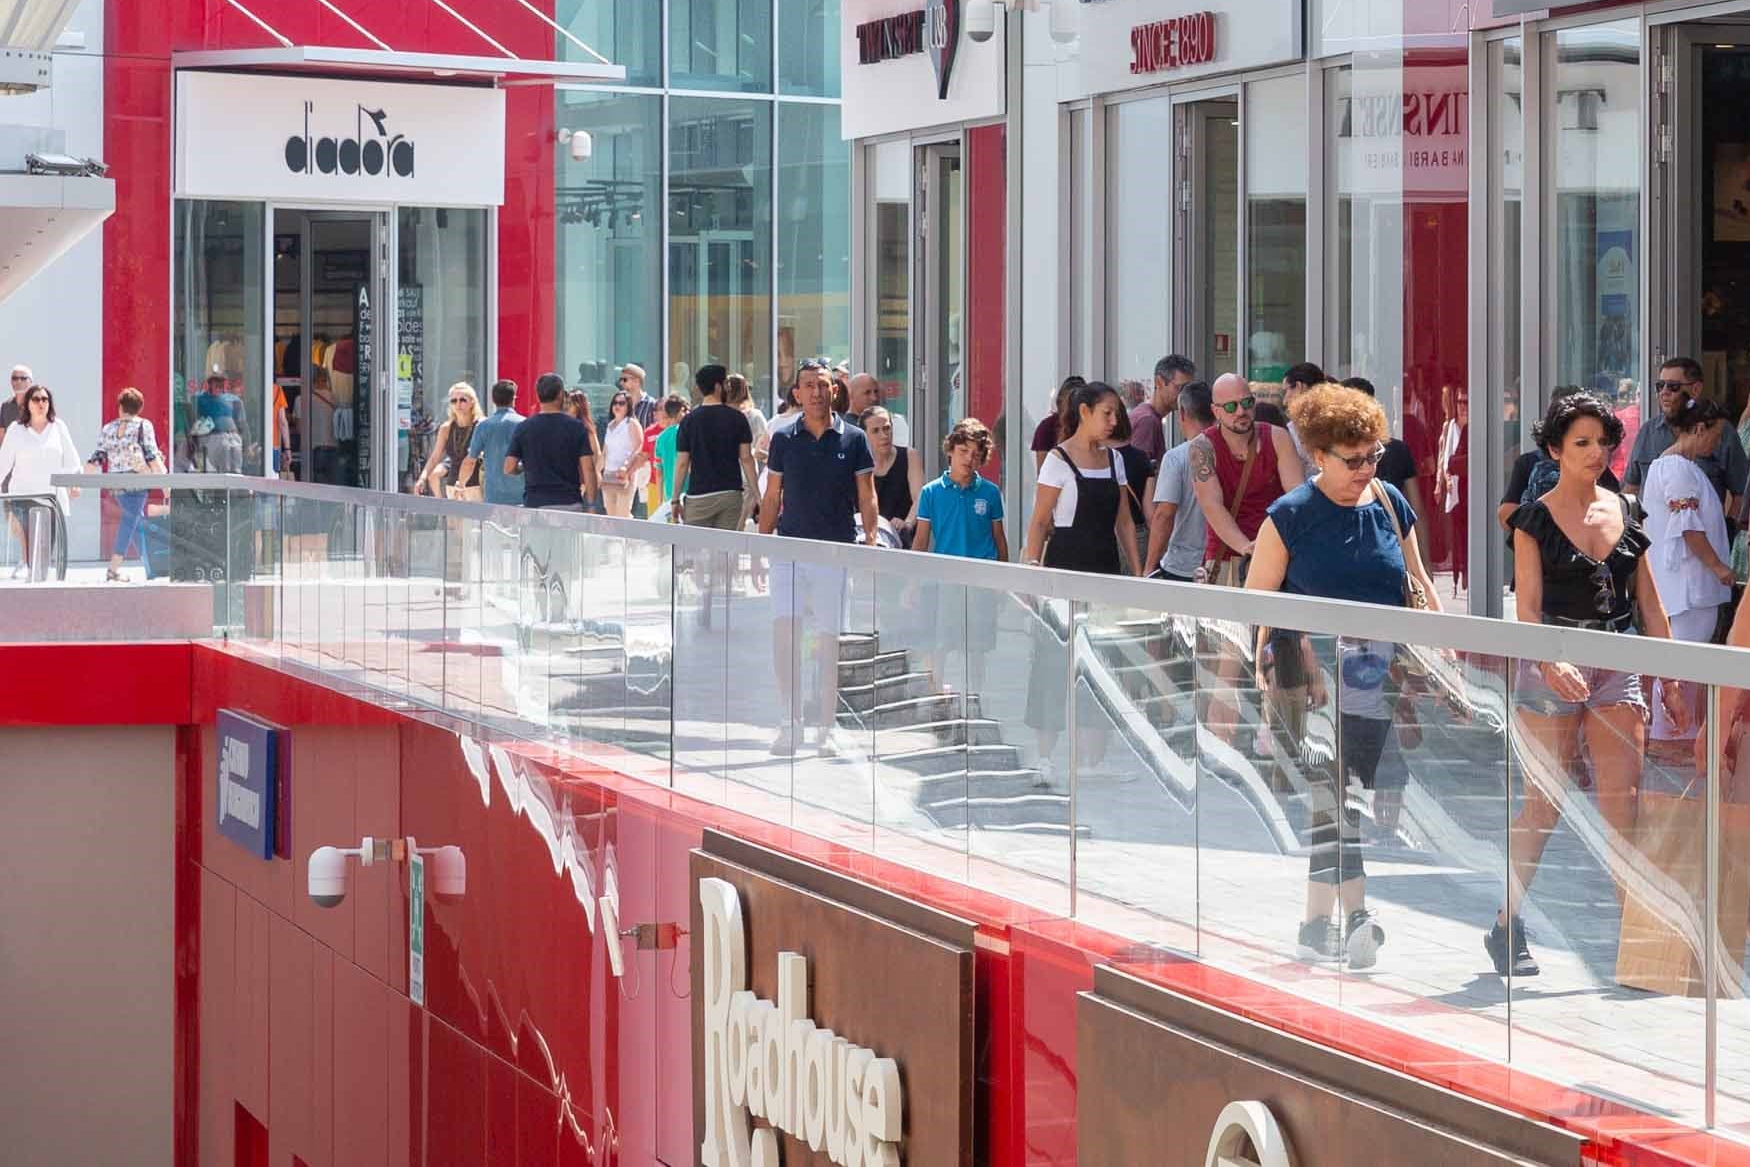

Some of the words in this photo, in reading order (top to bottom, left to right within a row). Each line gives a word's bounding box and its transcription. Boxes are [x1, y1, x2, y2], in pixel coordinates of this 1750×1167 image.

[1130, 18, 1176, 75] SINCE
[1174, 10, 1218, 67] 1890
[284, 100, 415, 179] diadora
[699, 877, 901, 1167] Roadhouse
